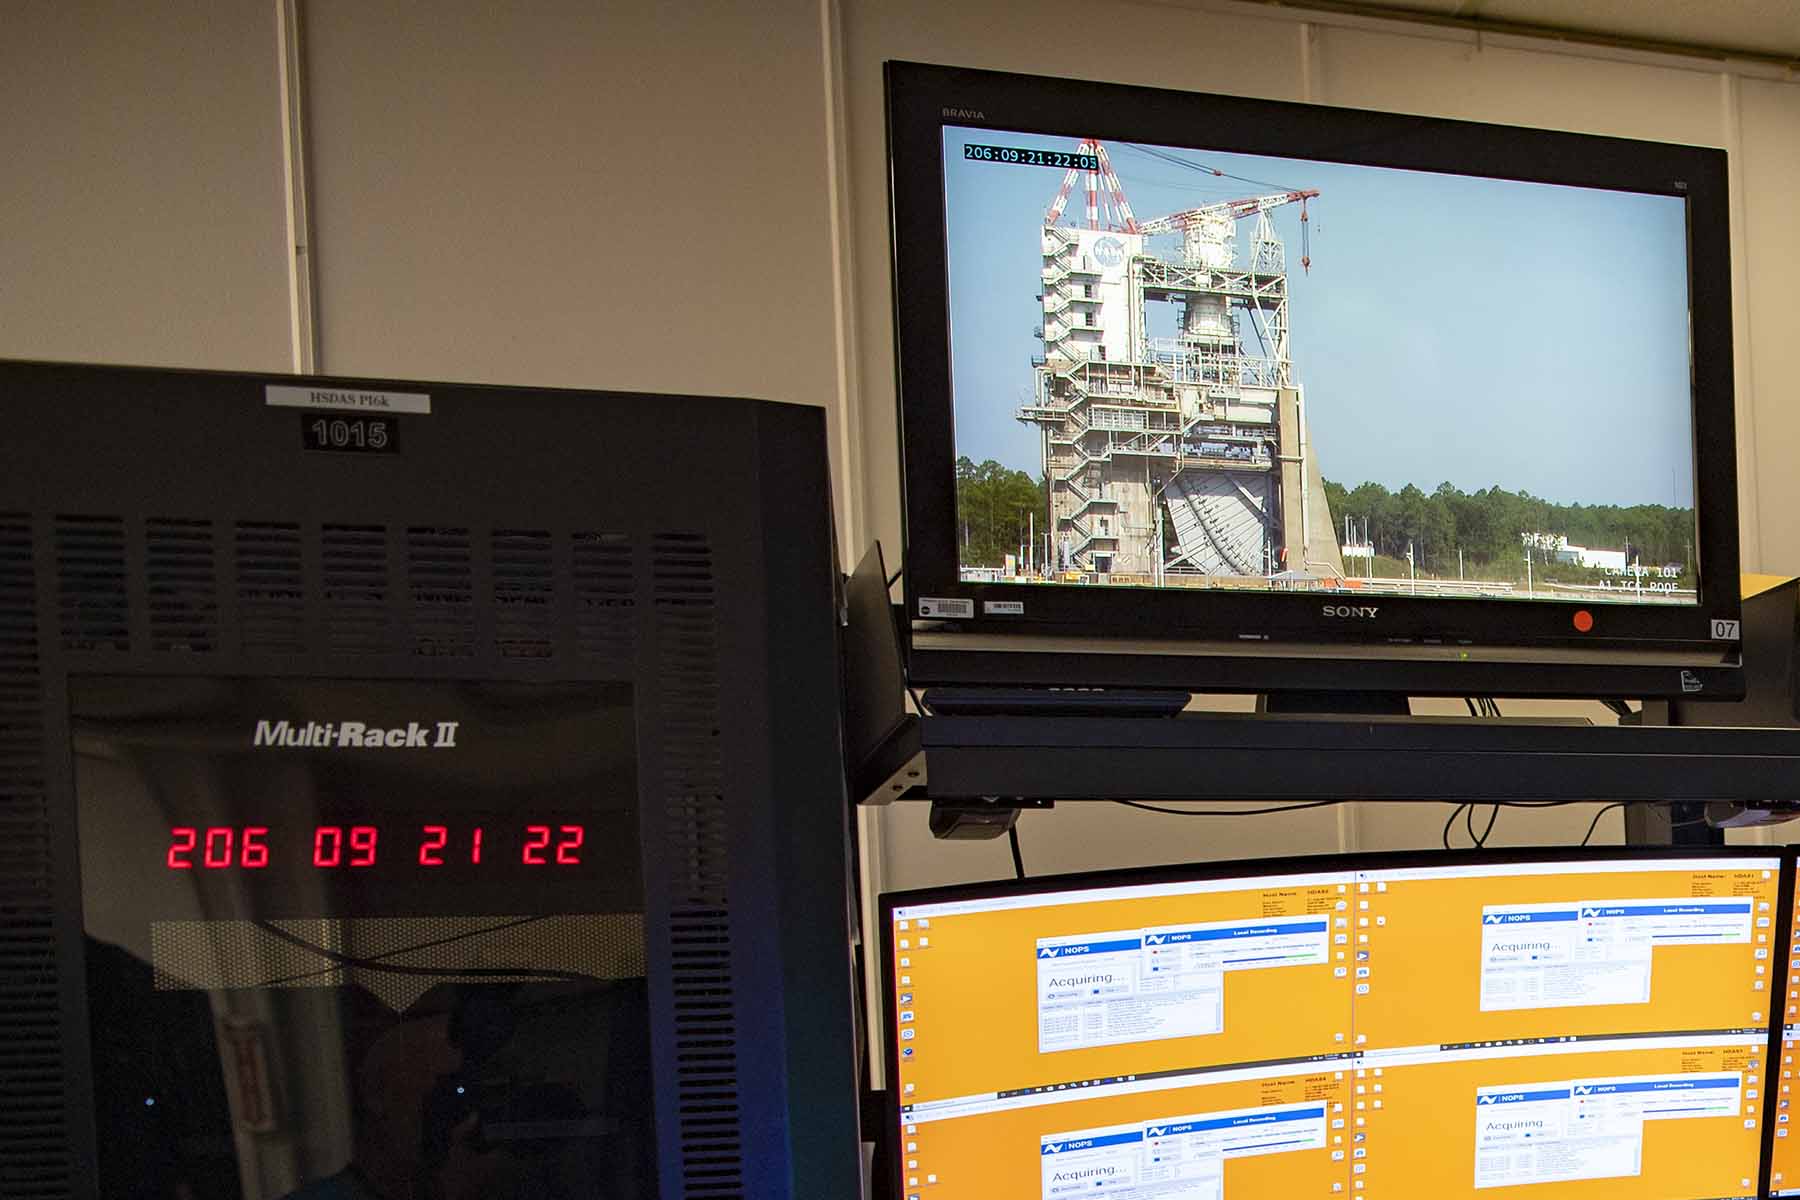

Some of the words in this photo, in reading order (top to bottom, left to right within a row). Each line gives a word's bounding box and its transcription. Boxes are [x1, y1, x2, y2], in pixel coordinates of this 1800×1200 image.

[942, 108, 985, 120] BRAVIA
[310, 391, 356, 405] HSDAS
[312, 419, 388, 448] 1015
[1657, 568, 1678, 579] 101
[1322, 605, 1380, 619] SONY
[1715, 622, 1734, 638] 07
[253, 719, 428, 749] Multi-Rack
[167, 827, 270, 869] 206
[313, 826, 378, 868] 09
[420, 825, 482, 866] 21
[523, 825, 585, 865] 22
[1508, 913, 1531, 922] NOPS
[1065, 946, 1089, 954] NOPS
[1502, 1094, 1524, 1102] NOPS
[1068, 1140, 1093, 1151] NOPS
